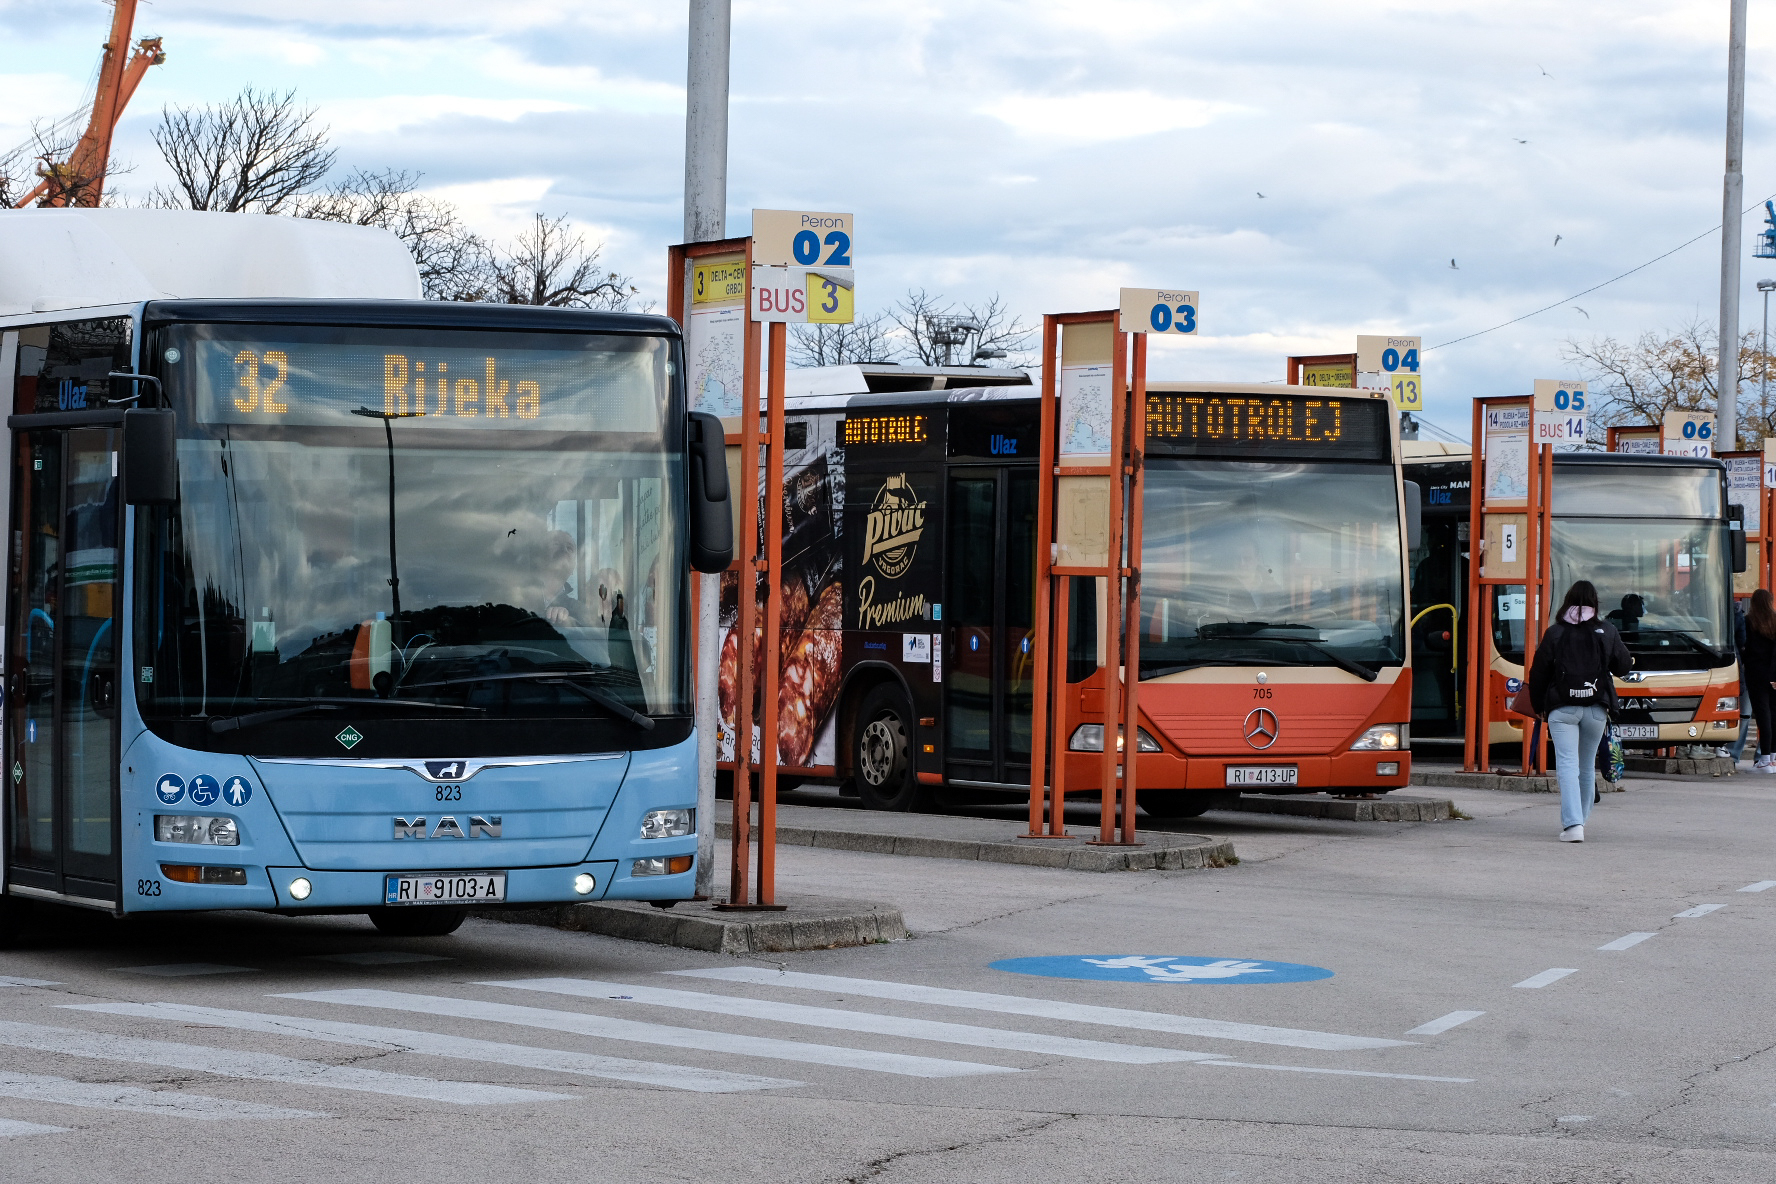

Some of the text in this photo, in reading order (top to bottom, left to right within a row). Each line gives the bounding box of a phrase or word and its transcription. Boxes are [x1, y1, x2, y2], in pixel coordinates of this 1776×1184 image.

[801, 214, 844, 228] Peron
[792, 230, 851, 266] 02
[697, 271, 704, 296] 3
[759, 280, 840, 314] BUS 3
[1157, 291, 1191, 303] Peron
[1150, 303, 1196, 333] 03
[1387, 338, 1415, 348] Peron
[1382, 348, 1420, 372] 04
[234, 350, 541, 419] 32 Rijeka
[1395, 380, 1418, 404] 13
[1558, 381, 1582, 390] Peron
[59, 380, 88, 410] Ulaz
[1554, 389, 1585, 411] 05
[1146, 396, 1341, 441] AUTOTROLEJ
[1489, 411, 1498, 428] 14
[1687, 413, 1709, 421] Peron
[1540, 417, 1584, 438] BUS 14
[1682, 421, 1712, 440] 06
[991, 434, 1017, 455] Ulaz
[1621, 441, 1630, 453] 12
[1692, 445, 1708, 458] 12
[1767, 467, 1776, 483] 1
[1450, 481, 1470, 489] MAN
[1430, 489, 1451, 504] Ulaz
[1506, 534, 1513, 549] 5
[878, 557, 909, 575] VRGORAC
[858, 575, 926, 630] Premium
[1502, 602, 1510, 612] 5
[1253, 688, 1273, 699] 705
[1569, 688, 1594, 698] PUMA
[340, 733, 358, 741] CNG
[1627, 726, 1655, 737] 5713-H
[1234, 770, 1296, 783] RI 413-UP
[435, 785, 462, 801] 823
[393, 816, 502, 839] MAN
[137, 879, 162, 897] 823
[399, 880, 419, 900] RI
[433, 878, 497, 899] 9103-A
